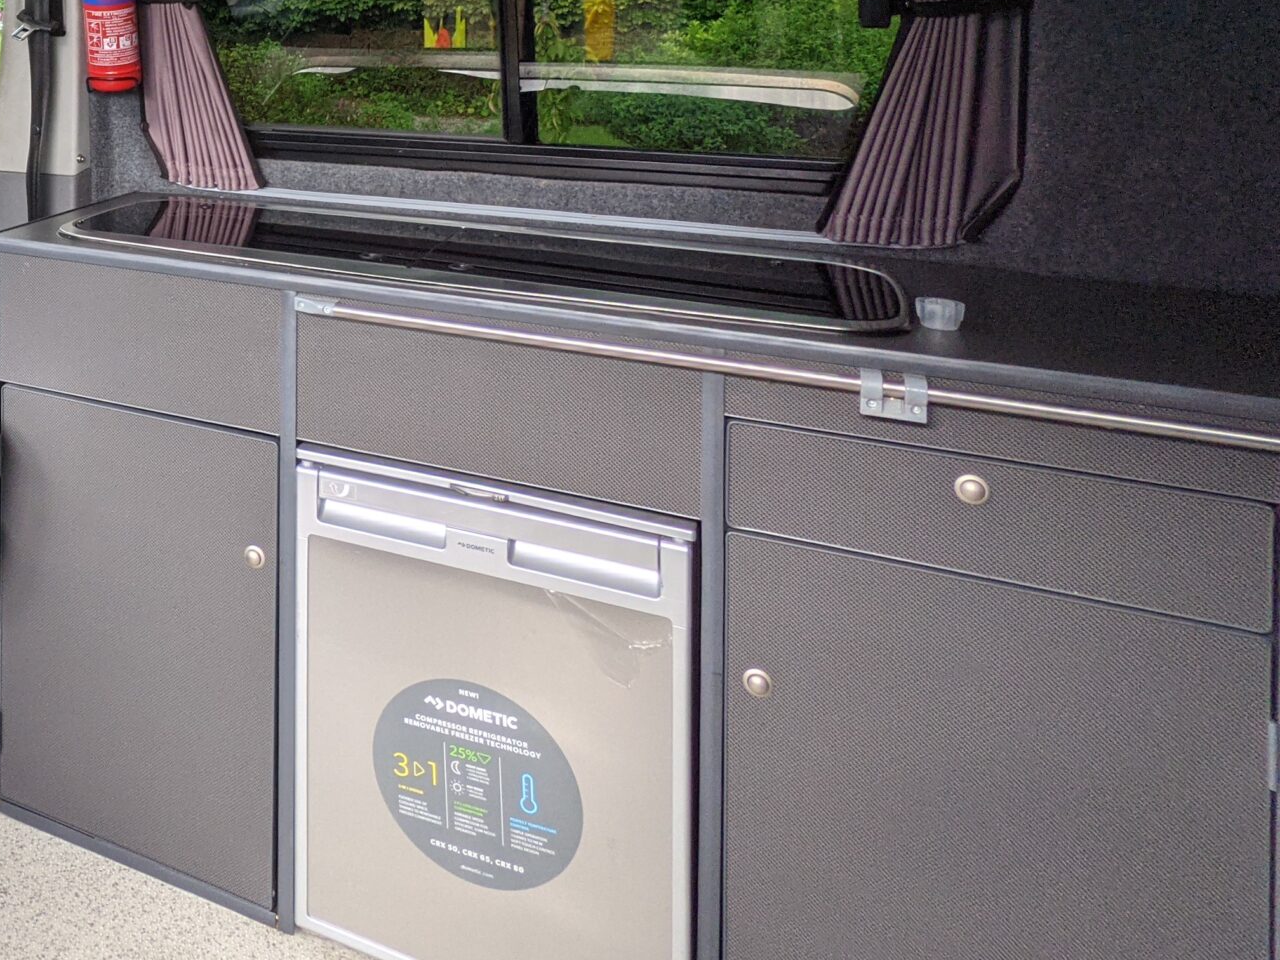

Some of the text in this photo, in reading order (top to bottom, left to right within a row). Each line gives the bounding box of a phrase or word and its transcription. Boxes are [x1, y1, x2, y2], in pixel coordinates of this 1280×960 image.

[466, 543, 495, 554] DOMETIC
[458, 688, 479, 700] NEW!
[446, 699, 518, 730] DOMETIC
[404, 717, 542, 760] REMOVABLE FREEZER TECHNOLOGY
[415, 713, 528, 749] COMPRESSOR REFRIGERATOR
[393, 751, 409, 777] 3
[427, 760, 438, 786] 1
[449, 744, 478, 763] 25%
[429, 838, 446, 849] CRX
[462, 848, 478, 859] CRX
[495, 859, 512, 870] CRX
